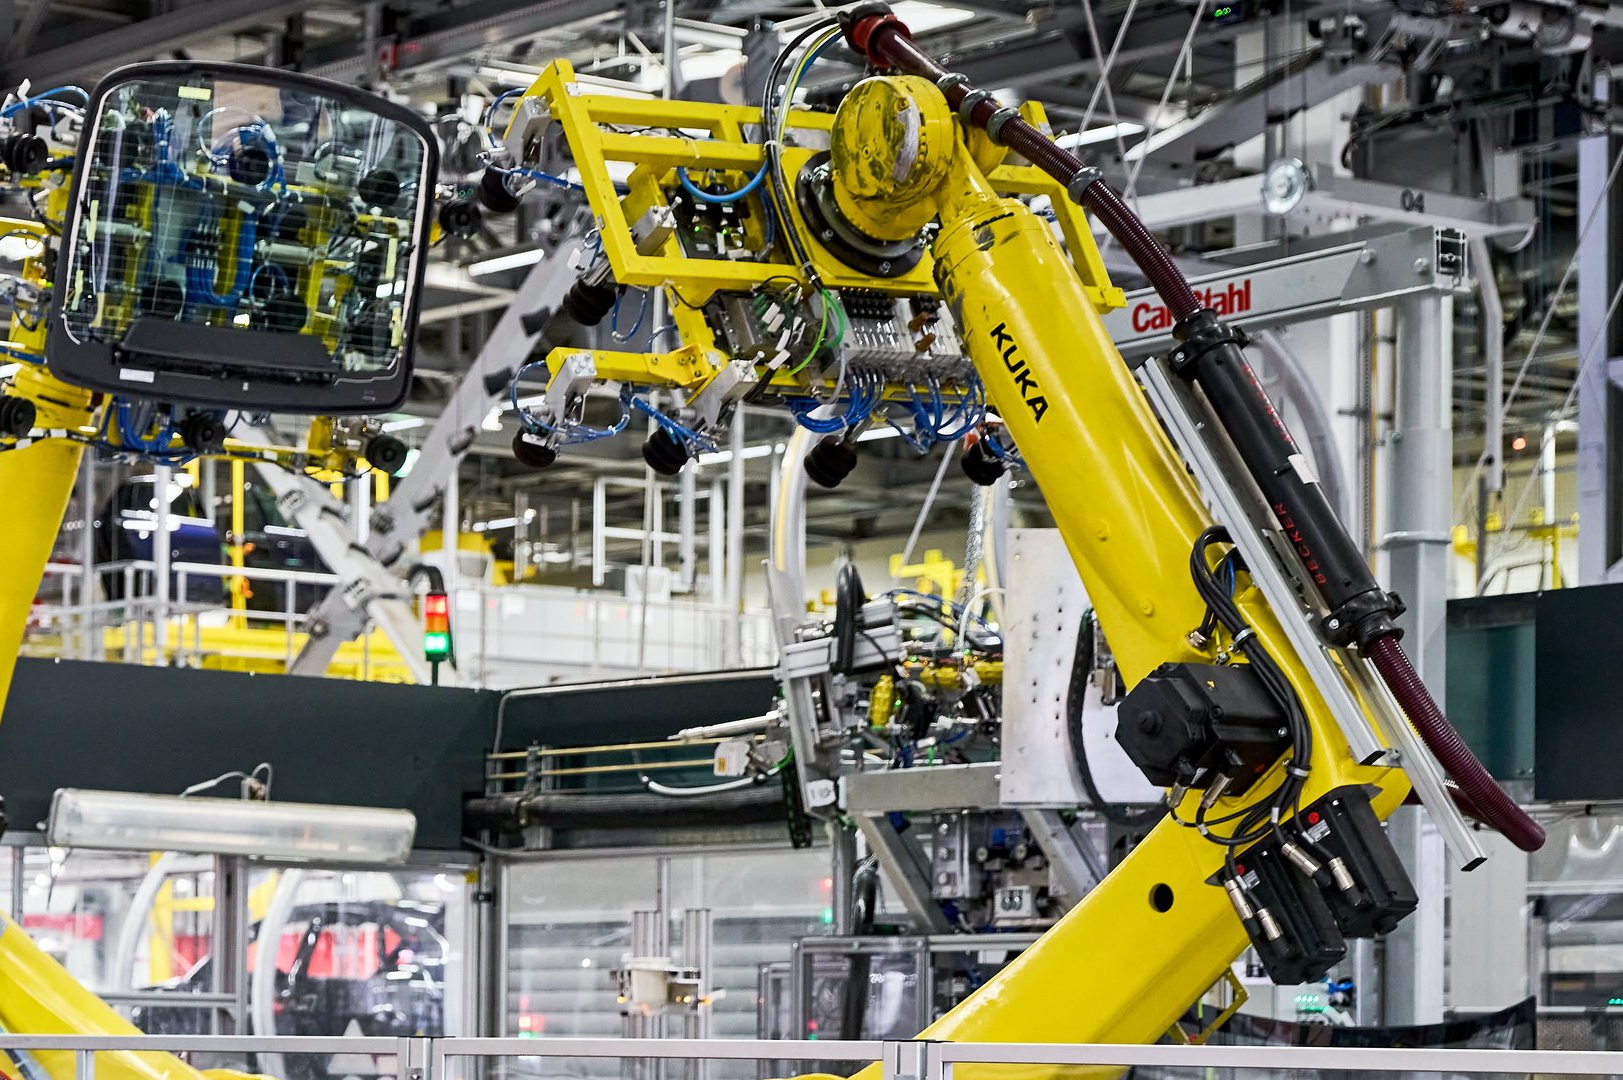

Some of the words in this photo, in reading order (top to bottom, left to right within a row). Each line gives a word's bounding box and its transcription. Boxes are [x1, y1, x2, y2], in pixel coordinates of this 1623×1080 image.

[1400, 189, 1425, 214] 04
[990, 322, 1049, 424] KUKA
[1275, 503, 1327, 584] BECKER
